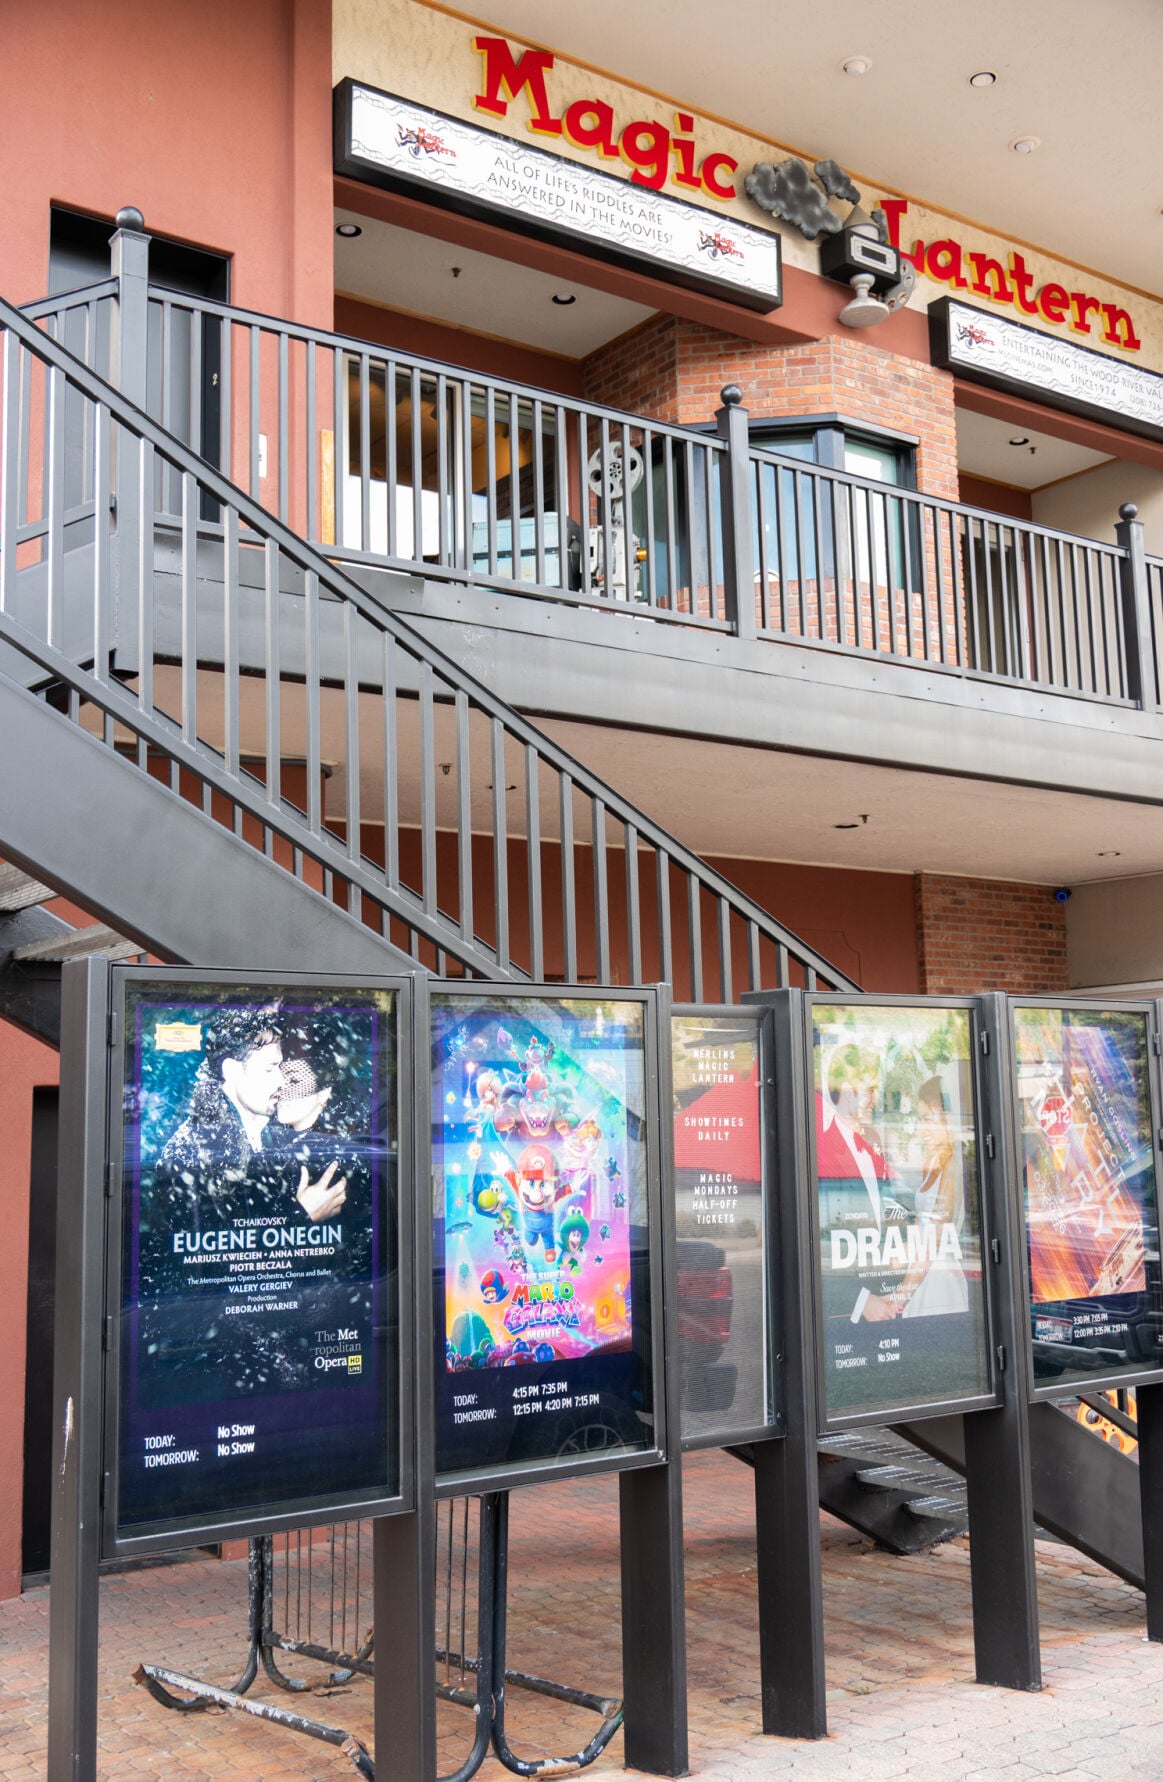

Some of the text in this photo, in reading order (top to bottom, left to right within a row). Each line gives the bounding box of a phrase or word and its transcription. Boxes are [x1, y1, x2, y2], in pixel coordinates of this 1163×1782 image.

[472, 36, 1141, 351] Magic Lantern
[494, 156, 663, 226] ALL OF LIFE'S RIDDLES ARE
[487, 172, 673, 245] ANSWERED IN THE MOVIES!
[1002, 335, 1071, 368] ENTERTAINING
[1073, 359, 1089, 376] THE
[1090, 367, 1120, 384] WOOD
[1121, 377, 1144, 394] RIVER
[212, 373, 218, 386] 2
[692, 1049, 735, 1060] MERLINS
[698, 1061, 729, 1071] MAGIC
[692, 1073, 735, 1083] LANTERN
[684, 1117, 744, 1127] SHOWTIMES
[1089, 1068, 1109, 1104] RYAN
[1108, 1107, 1137, 1162] GOSLING
[698, 1131, 730, 1141] DAILY
[1072, 1081, 1127, 1186] PROJECT
[699, 1173, 733, 1184] MAGIC
[694, 1185, 738, 1196] MONDAYS
[692, 1200, 738, 1210] HALF-OFF
[232, 1216, 288, 1228] TCHAIKOVSKY
[697, 1213, 735, 1224] TICKETS
[173, 1224, 343, 1253] EUGENE ONEGIN
[830, 1223, 963, 1270] DRAMA
[183, 1246, 335, 1265] MARIUSZ KWIECIEN ANNA NETREBKO
[229, 1260, 293, 1273] PIOTR BECZALA
[187, 1268, 332, 1286] The Metropolitan Opera Orchestra, Chorus and Ballet
[520, 1270, 566, 1282] THE SUPER
[228, 1281, 294, 1294] VALERY GERGIEV
[511, 1281, 575, 1305] MARIO
[247, 1293, 278, 1302] Production
[225, 1302, 299, 1315] DEBORAH WARNER
[503, 1298, 583, 1336] GALAXY
[315, 1328, 359, 1343] The Met
[526, 1327, 561, 1341] MOVIE
[314, 1341, 362, 1357] ropolitan
[890, 1338, 900, 1348] PM
[314, 1356, 361, 1371] Opera HD
[877, 1354, 885, 1363] No
[885, 1352, 900, 1362] Show
[349, 1365, 361, 1373] LIVE
[453, 1382, 568, 1408] TODAY: 4:15 PM 7:35 PM
[453, 1393, 600, 1424] TOMORROW: 12:15 PM 4:20 PM 7:15 PM
[144, 1424, 256, 1450] TODAY: No Show
[144, 1442, 256, 1468] TOMORROW: No Show
